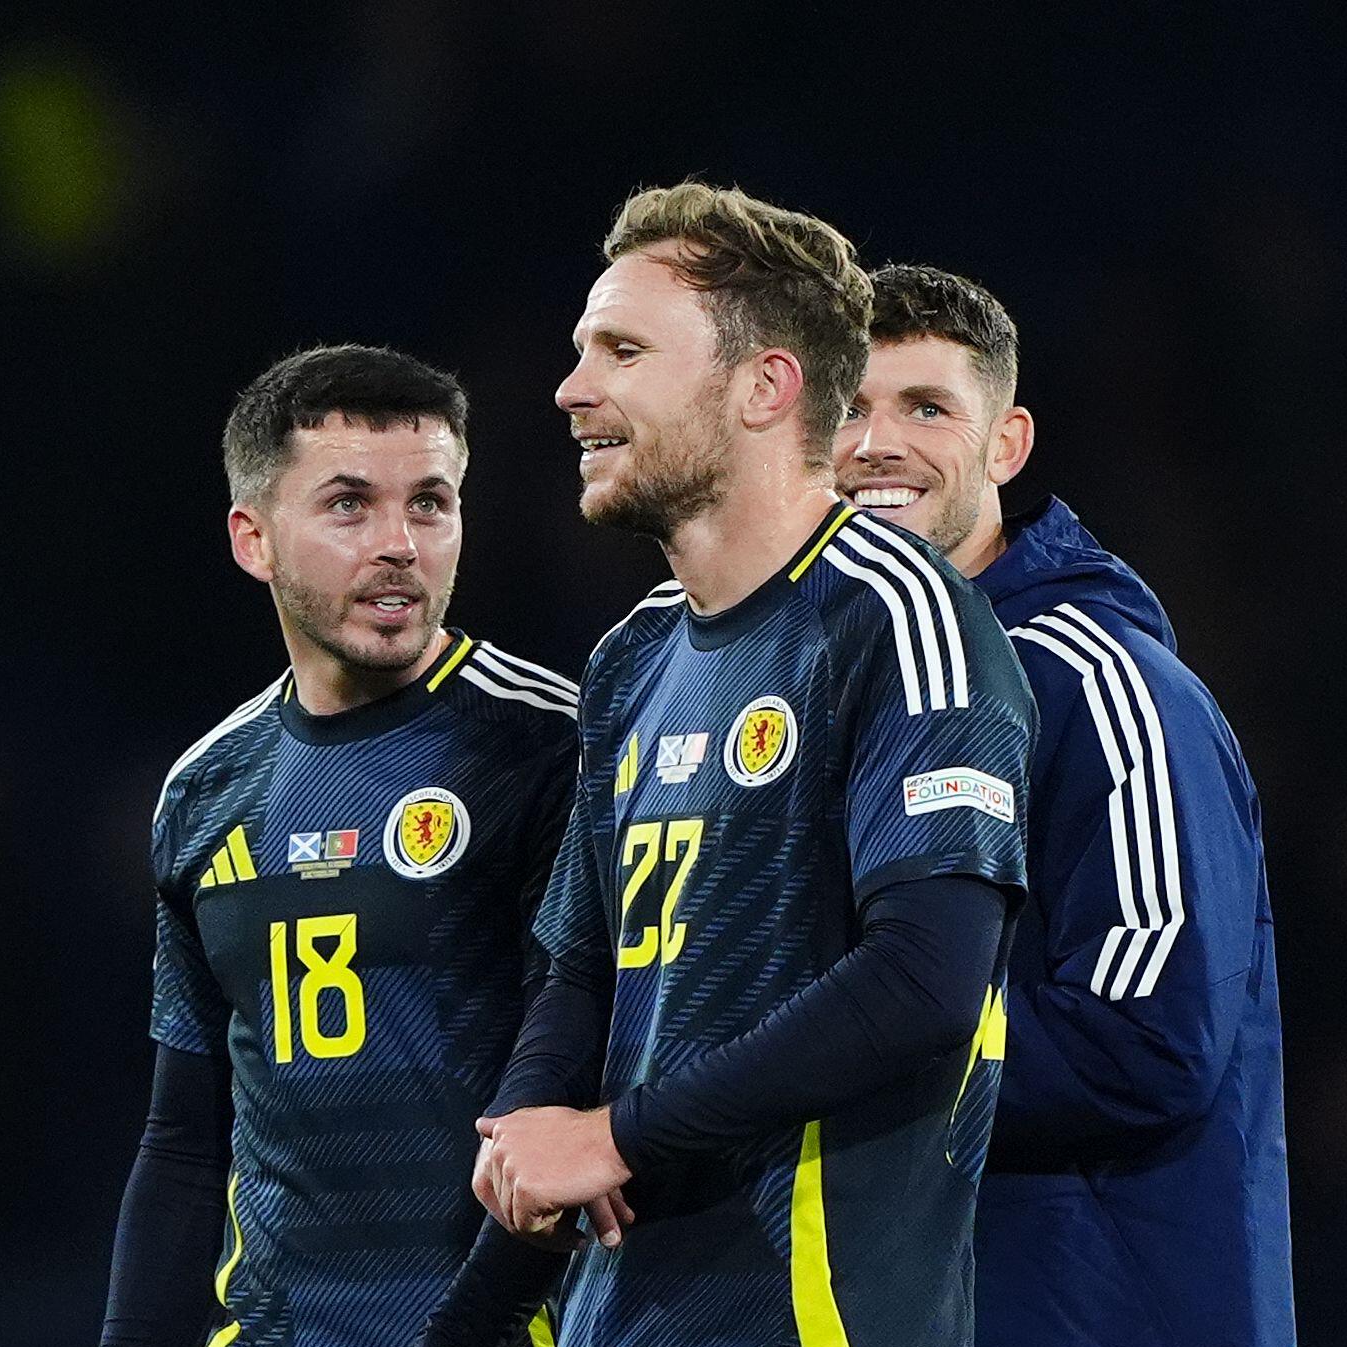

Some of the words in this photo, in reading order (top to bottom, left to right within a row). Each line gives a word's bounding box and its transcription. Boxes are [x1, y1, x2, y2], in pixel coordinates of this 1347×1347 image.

[410, 790, 450, 801] SCOTLAND
[907, 780, 1011, 809] FOUNDATION
[617, 819, 704, 969] 22
[269, 914, 367, 1063] 18
